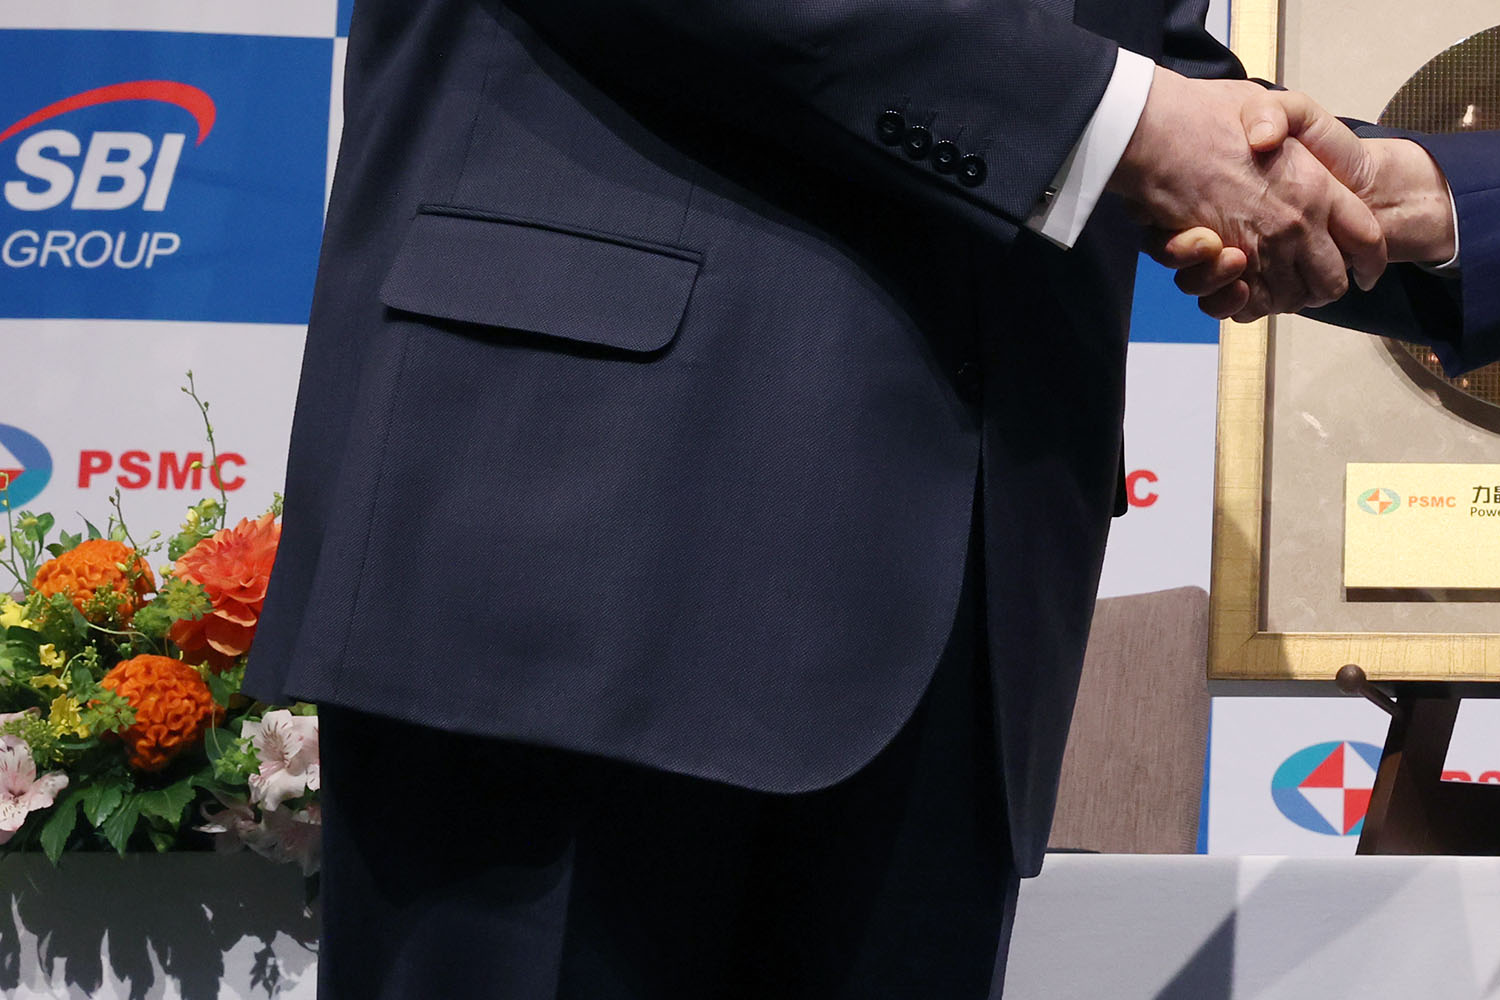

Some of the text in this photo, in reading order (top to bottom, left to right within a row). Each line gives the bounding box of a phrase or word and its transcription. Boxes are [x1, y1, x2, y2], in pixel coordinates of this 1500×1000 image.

[4, 129, 186, 212] SBI
[2, 230, 181, 269] GROUP
[77, 449, 248, 492] PSMC
[1408, 495, 1457, 508] PSMC
